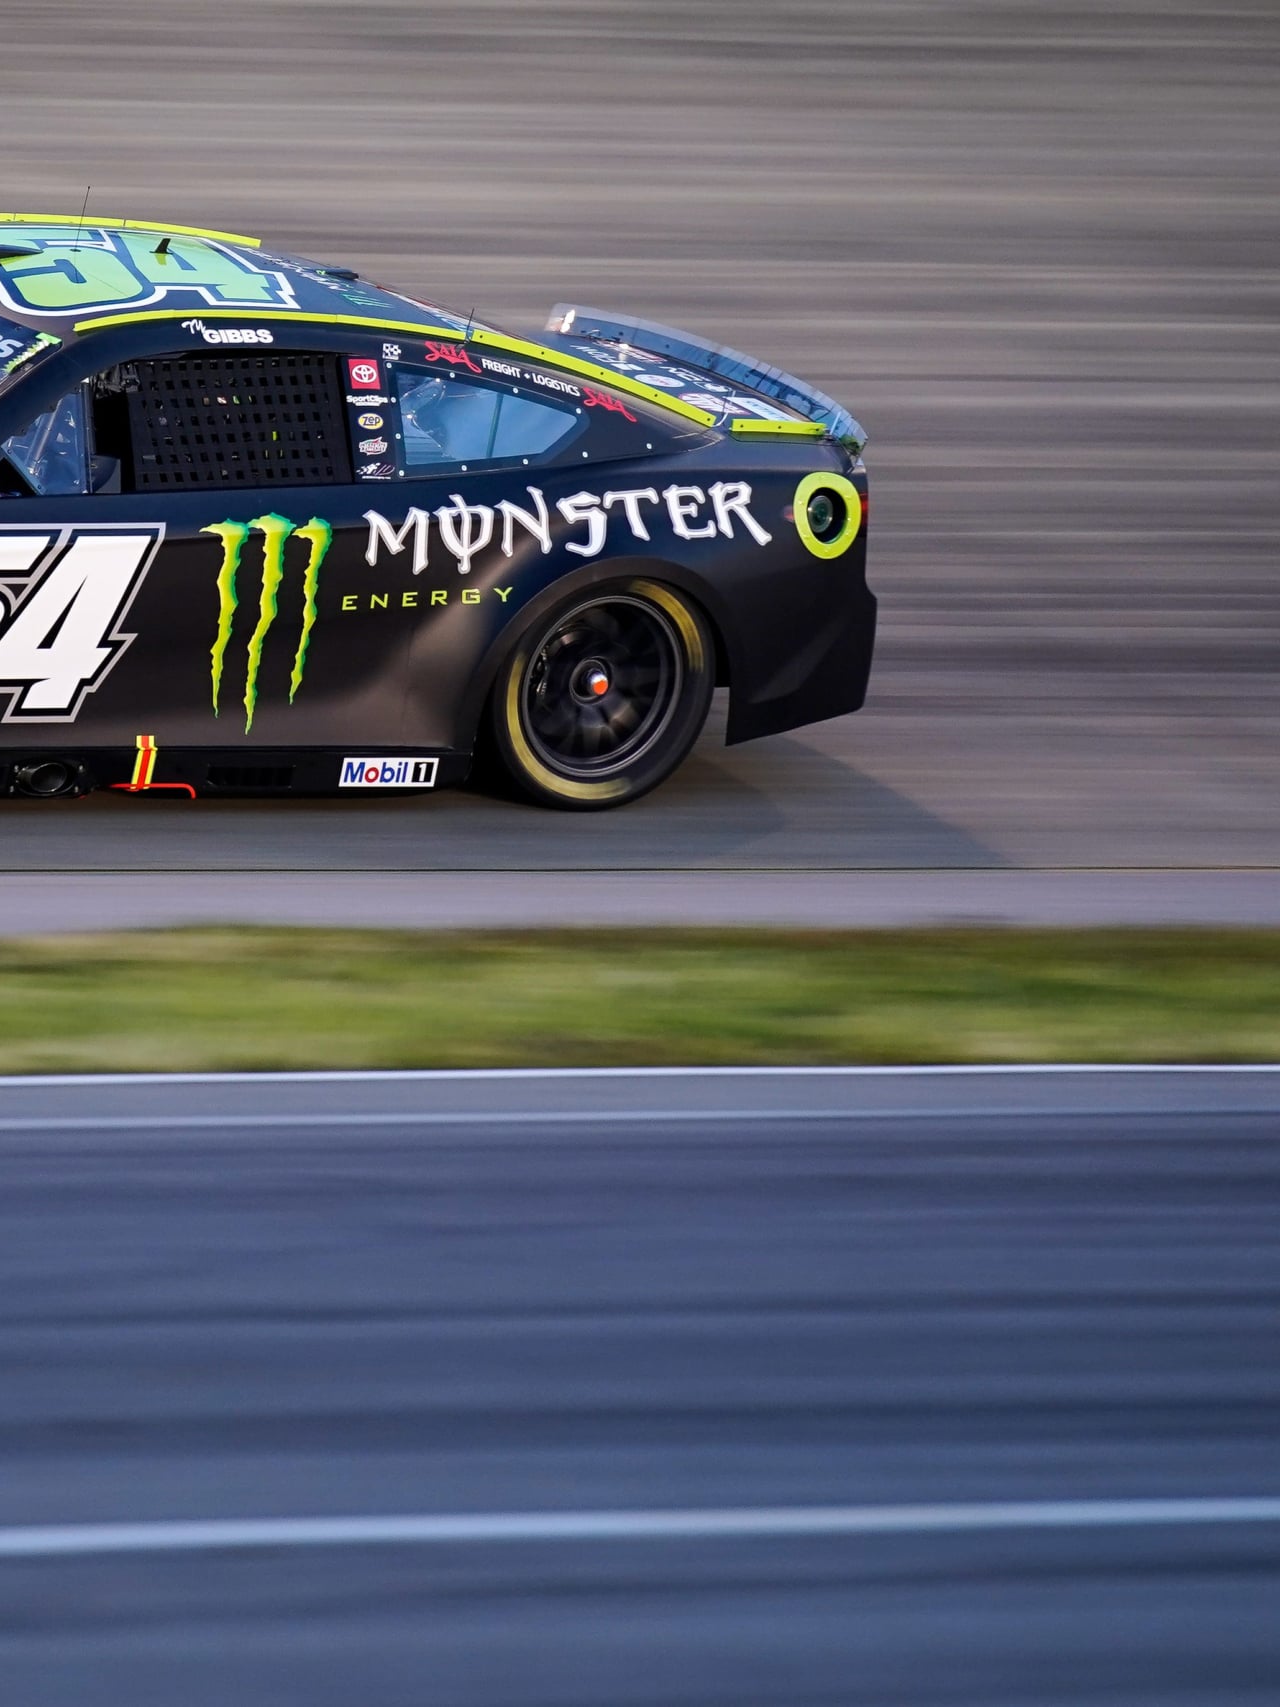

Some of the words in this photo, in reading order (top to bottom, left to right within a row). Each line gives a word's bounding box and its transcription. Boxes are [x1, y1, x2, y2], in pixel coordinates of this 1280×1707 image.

[203, 329, 274, 344] GIBBS
[481, 358, 521, 379] FREIGHT
[531, 372, 581, 397] LOGISTICS
[341, 586, 514, 611] ENERGY
[343, 762, 408, 783] Mobil
[418, 763, 428, 782] 1
